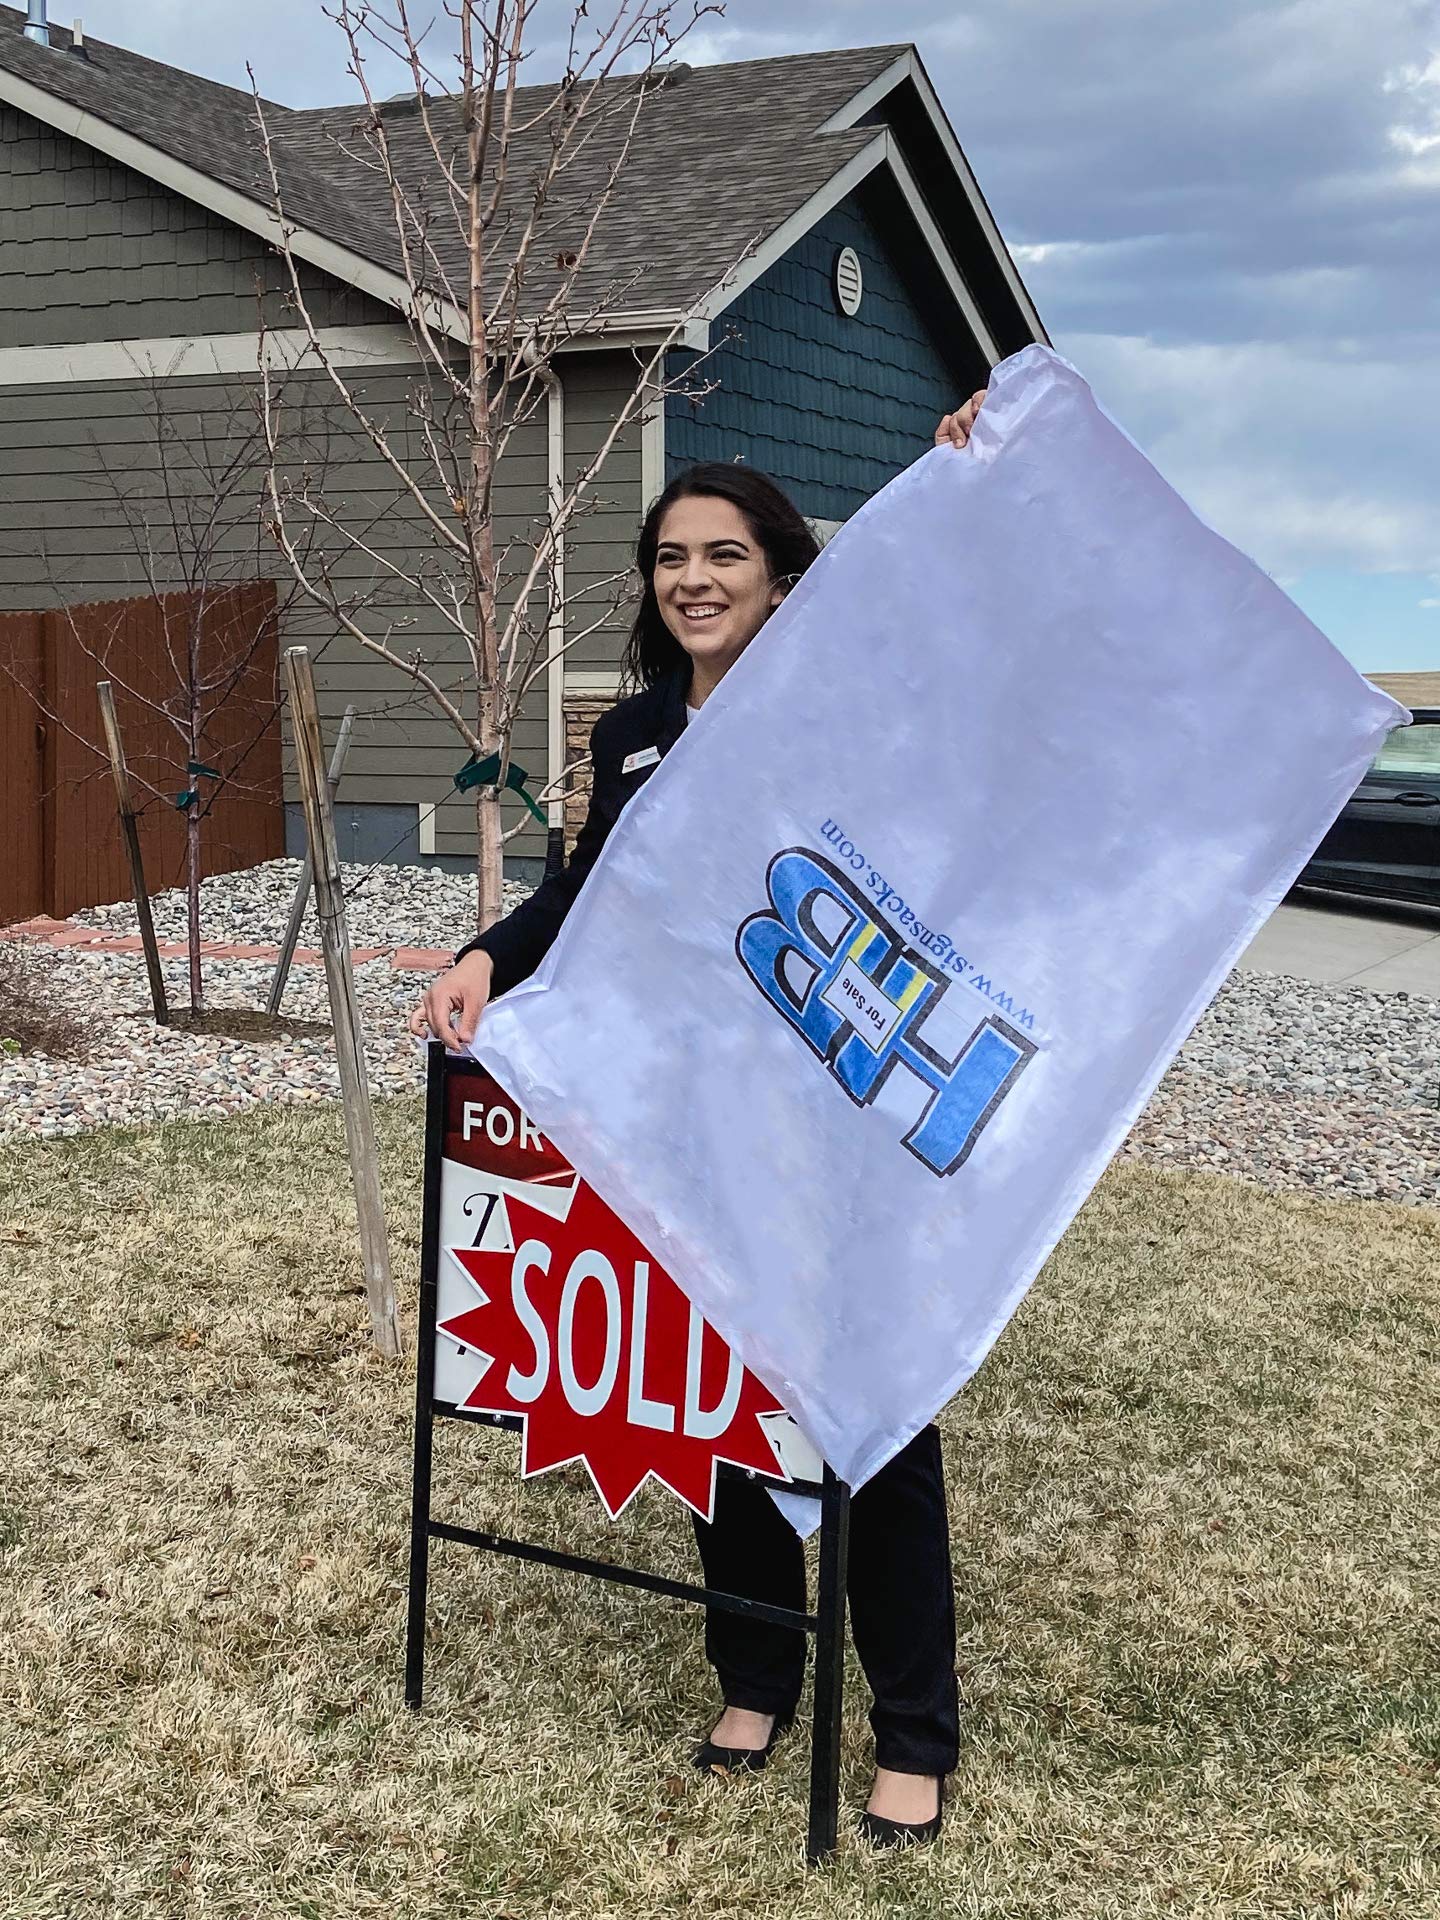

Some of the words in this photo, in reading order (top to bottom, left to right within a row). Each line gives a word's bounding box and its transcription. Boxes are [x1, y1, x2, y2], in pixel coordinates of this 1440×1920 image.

[820, 817, 1035, 1029] www.signsacks.com
[842, 978, 866, 1009] Sale
[865, 1006, 886, 1030] For
[463, 1101, 544, 1152] FOR
[505, 1239, 744, 1440] SOLD
